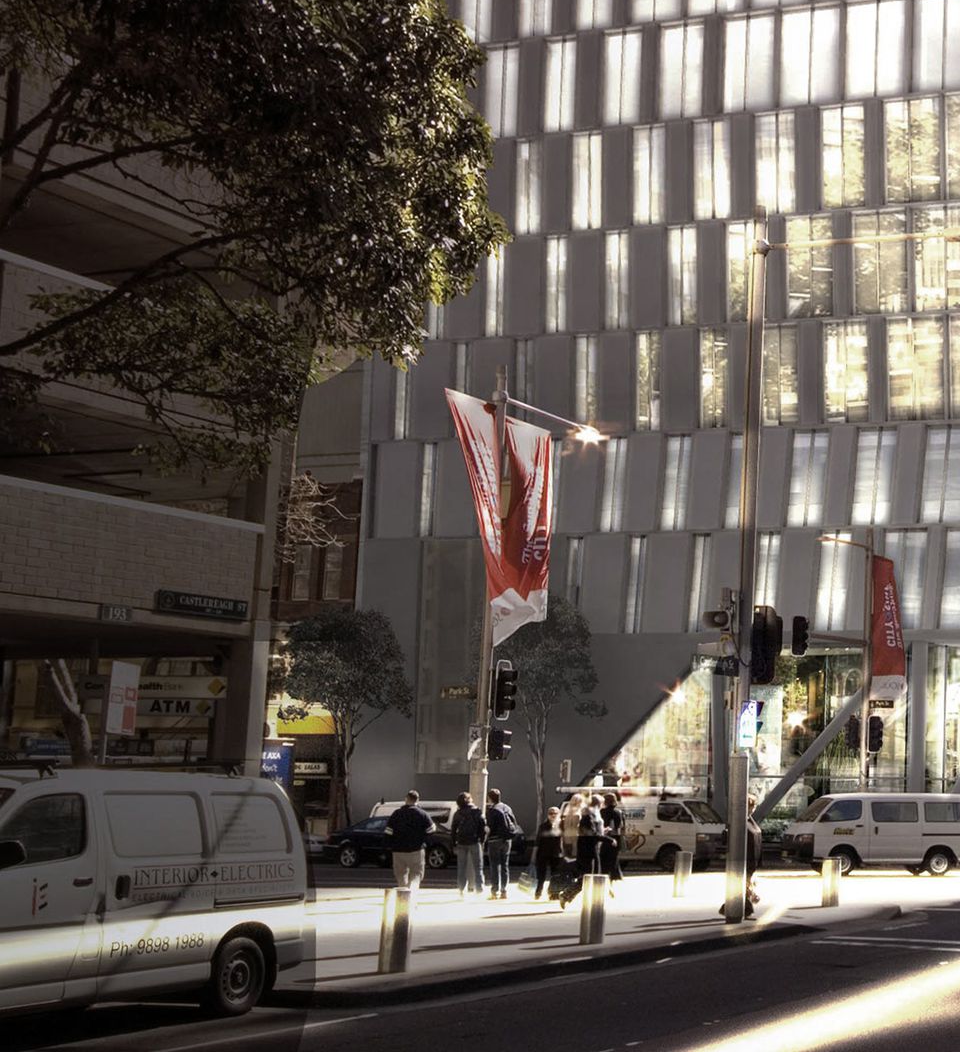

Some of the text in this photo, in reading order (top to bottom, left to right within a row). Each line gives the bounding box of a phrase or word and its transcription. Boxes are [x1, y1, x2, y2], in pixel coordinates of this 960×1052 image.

[179, 595, 234, 611] CASTLEREAGH
[237, 602, 247, 612] ST
[108, 607, 128, 620] 193
[150, 700, 190, 713] ATM
[134, 862, 295, 885] INTERIOR ELECTRICS
[110, 933, 204, 958] Ph: 9898 1988
